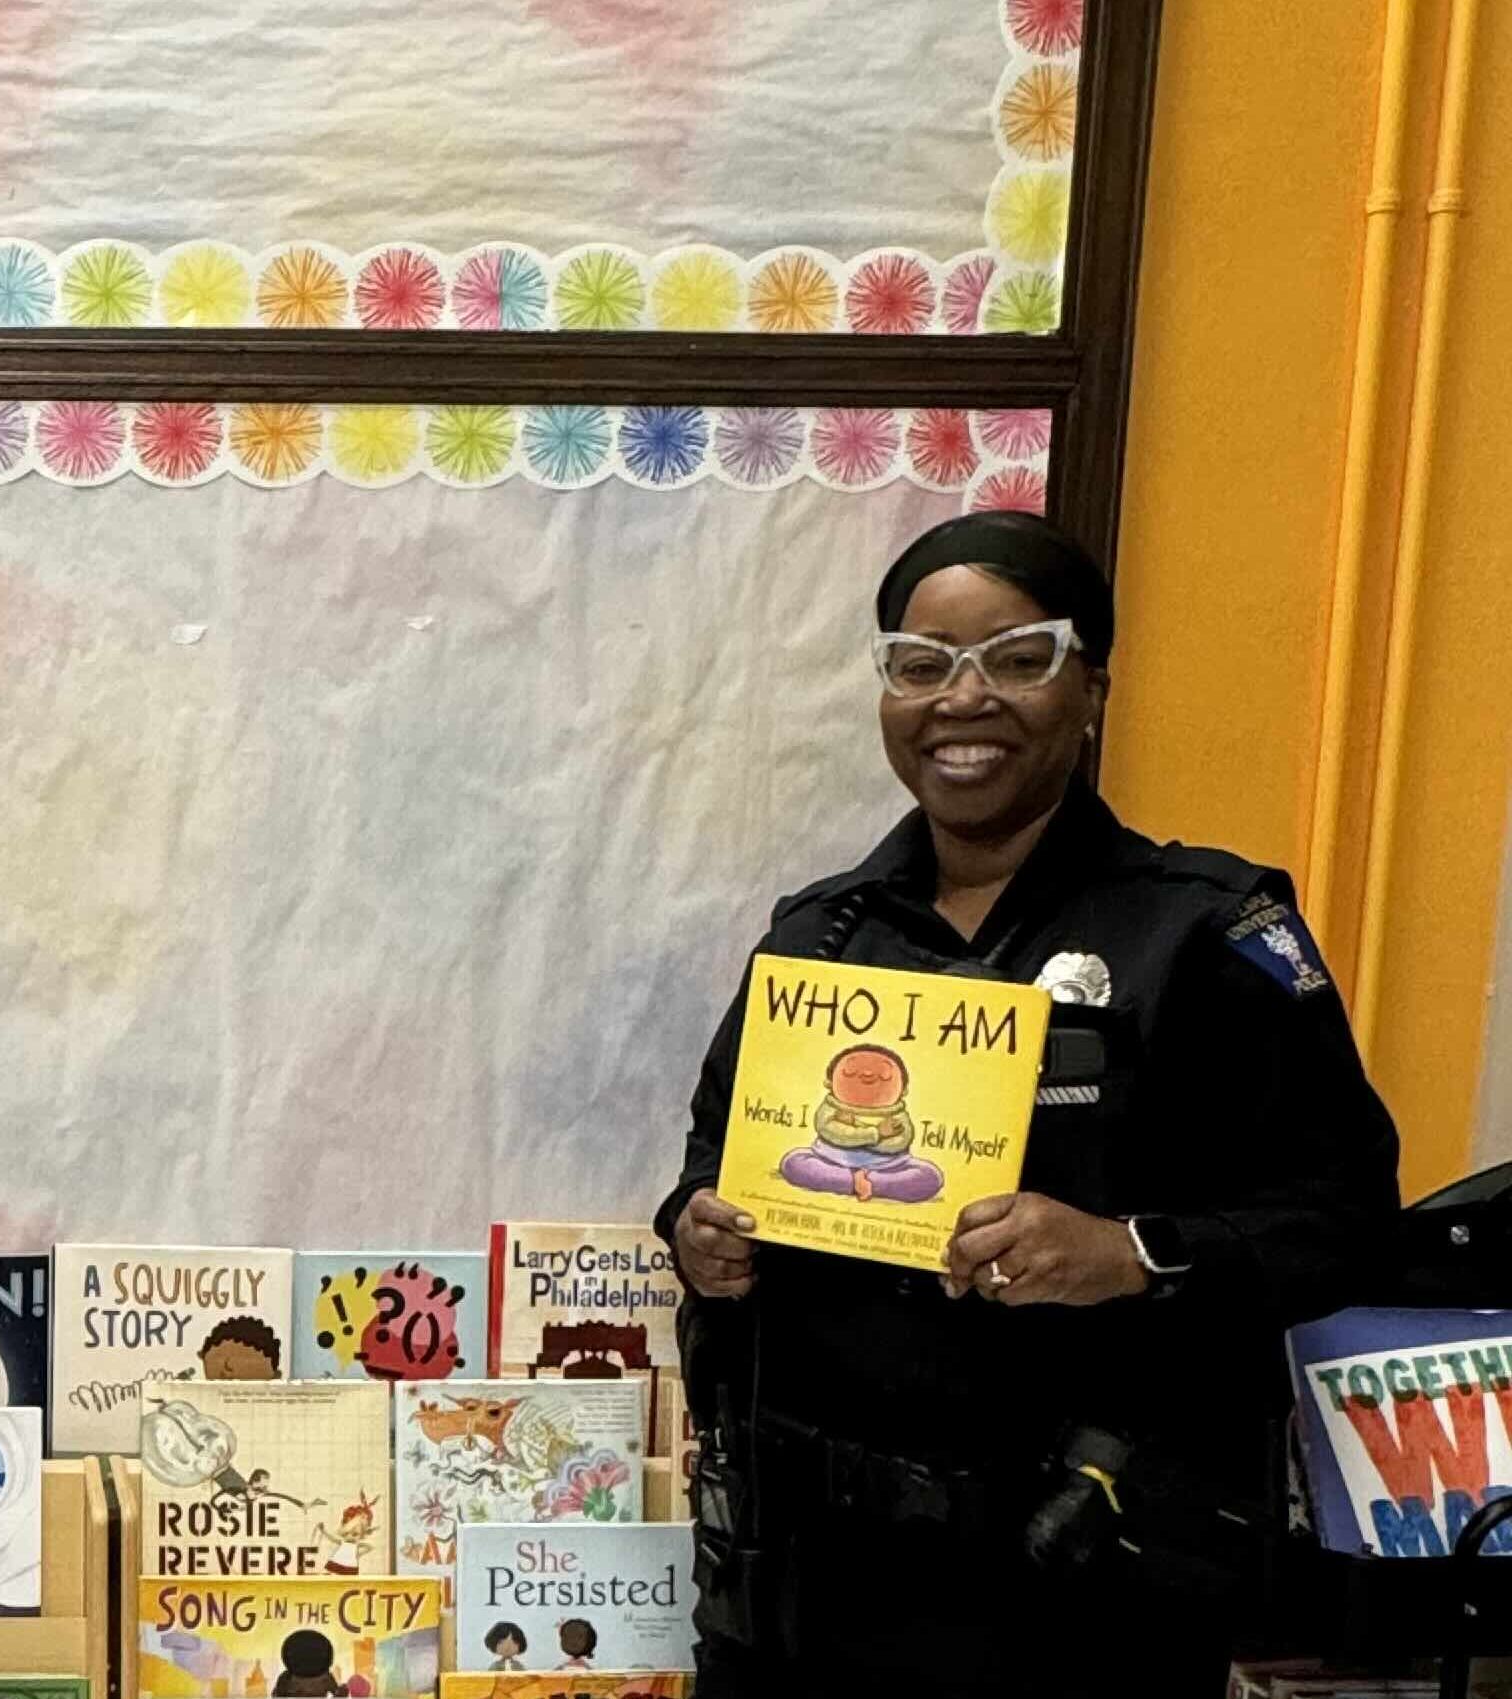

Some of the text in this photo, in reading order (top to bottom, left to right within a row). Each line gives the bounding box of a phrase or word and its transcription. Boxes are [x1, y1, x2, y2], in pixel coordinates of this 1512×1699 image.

[767, 975, 1017, 1055] WHO I AM
[744, 1097, 810, 1128] Words I
[920, 1120, 1009, 1164] Tell Myself
[513, 1240, 675, 1278] Larry Gets Los
[83, 1262, 266, 1309] A SQUIGGLY
[530, 1273, 677, 1317] Philadelphia
[84, 1307, 193, 1349] STORY
[1316, 1343, 1512, 1412] TOGETH
[158, 1502, 280, 1537] ROSIE
[158, 1545, 320, 1576] REVERE
[516, 1540, 578, 1574] She
[485, 1563, 679, 1608] Persisted
[156, 1586, 257, 1632] SONG
[264, 1596, 288, 1620] IN
[296, 1602, 330, 1625] THE
[338, 1588, 427, 1633] CITY
